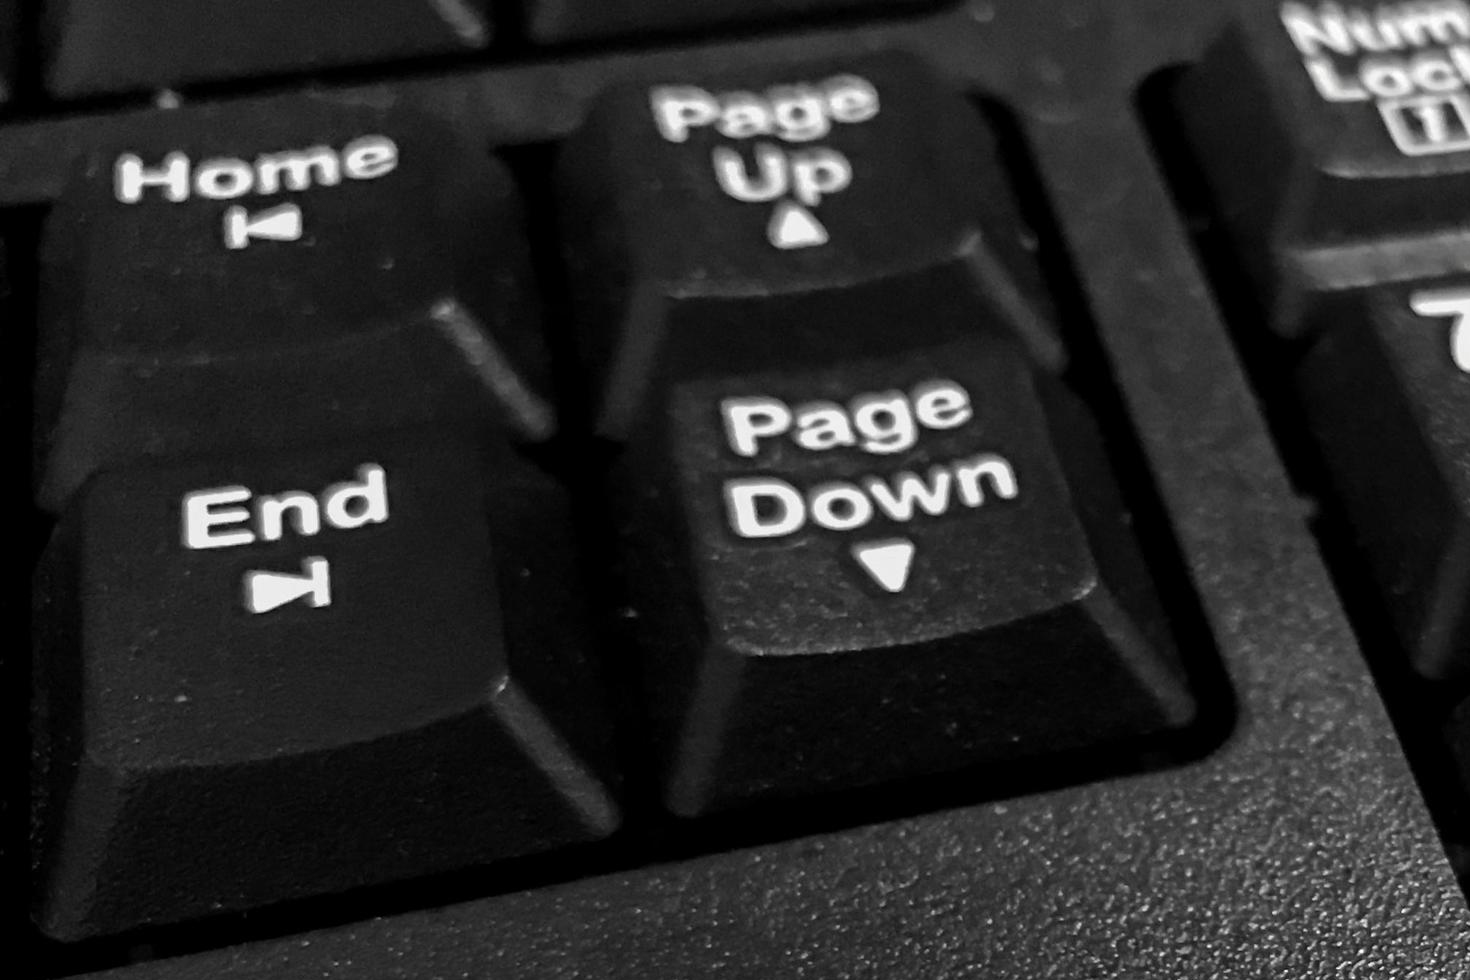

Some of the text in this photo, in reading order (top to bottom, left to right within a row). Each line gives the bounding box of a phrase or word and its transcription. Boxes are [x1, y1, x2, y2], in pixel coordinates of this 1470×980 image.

[650, 74, 880, 142] Page
[115, 135, 398, 203] Home
[712, 145, 853, 206] Up
[720, 379, 973, 456] Page
[181, 463, 389, 549] End
[723, 453, 1019, 538] Down
